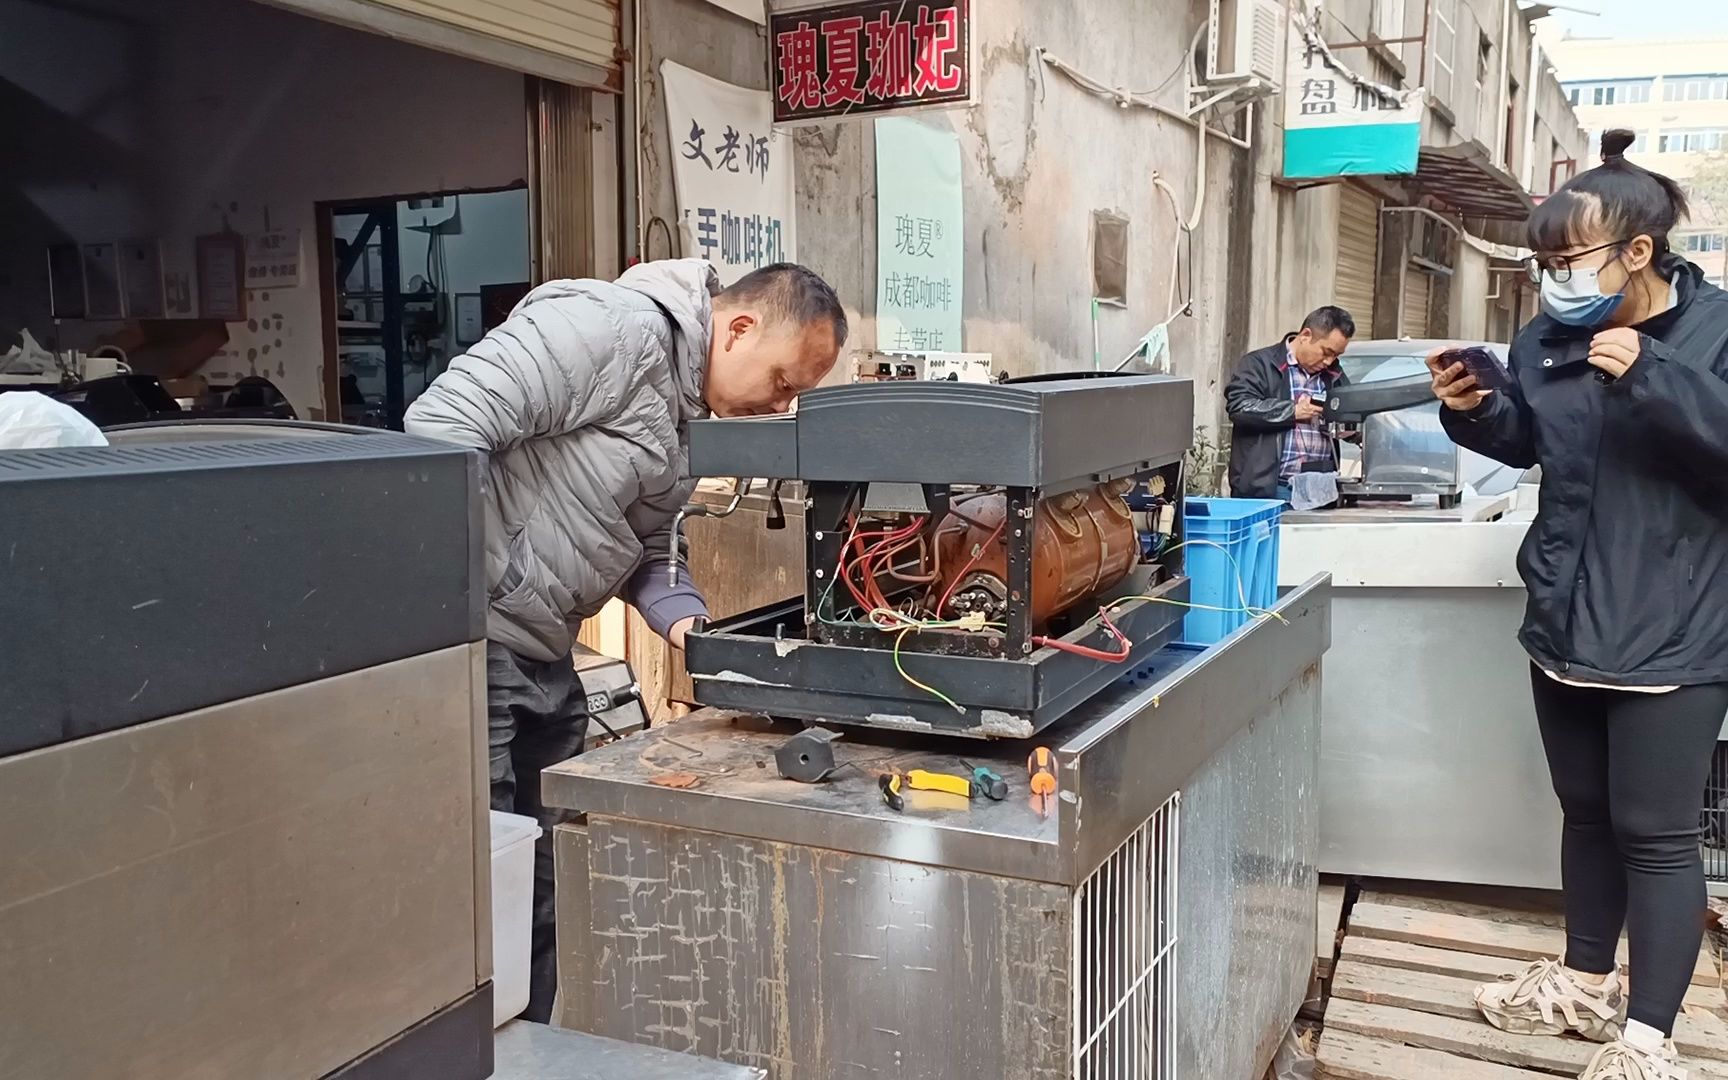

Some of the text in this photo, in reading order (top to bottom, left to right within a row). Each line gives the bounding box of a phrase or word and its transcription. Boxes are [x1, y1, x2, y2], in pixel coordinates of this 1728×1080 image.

[777, 5, 961, 110] 瑰夏珈妃
[680, 118, 770, 184] 文老师
[684, 207, 785, 270] 手咖啡机
[884, 271, 952, 311] 成都咖啡
